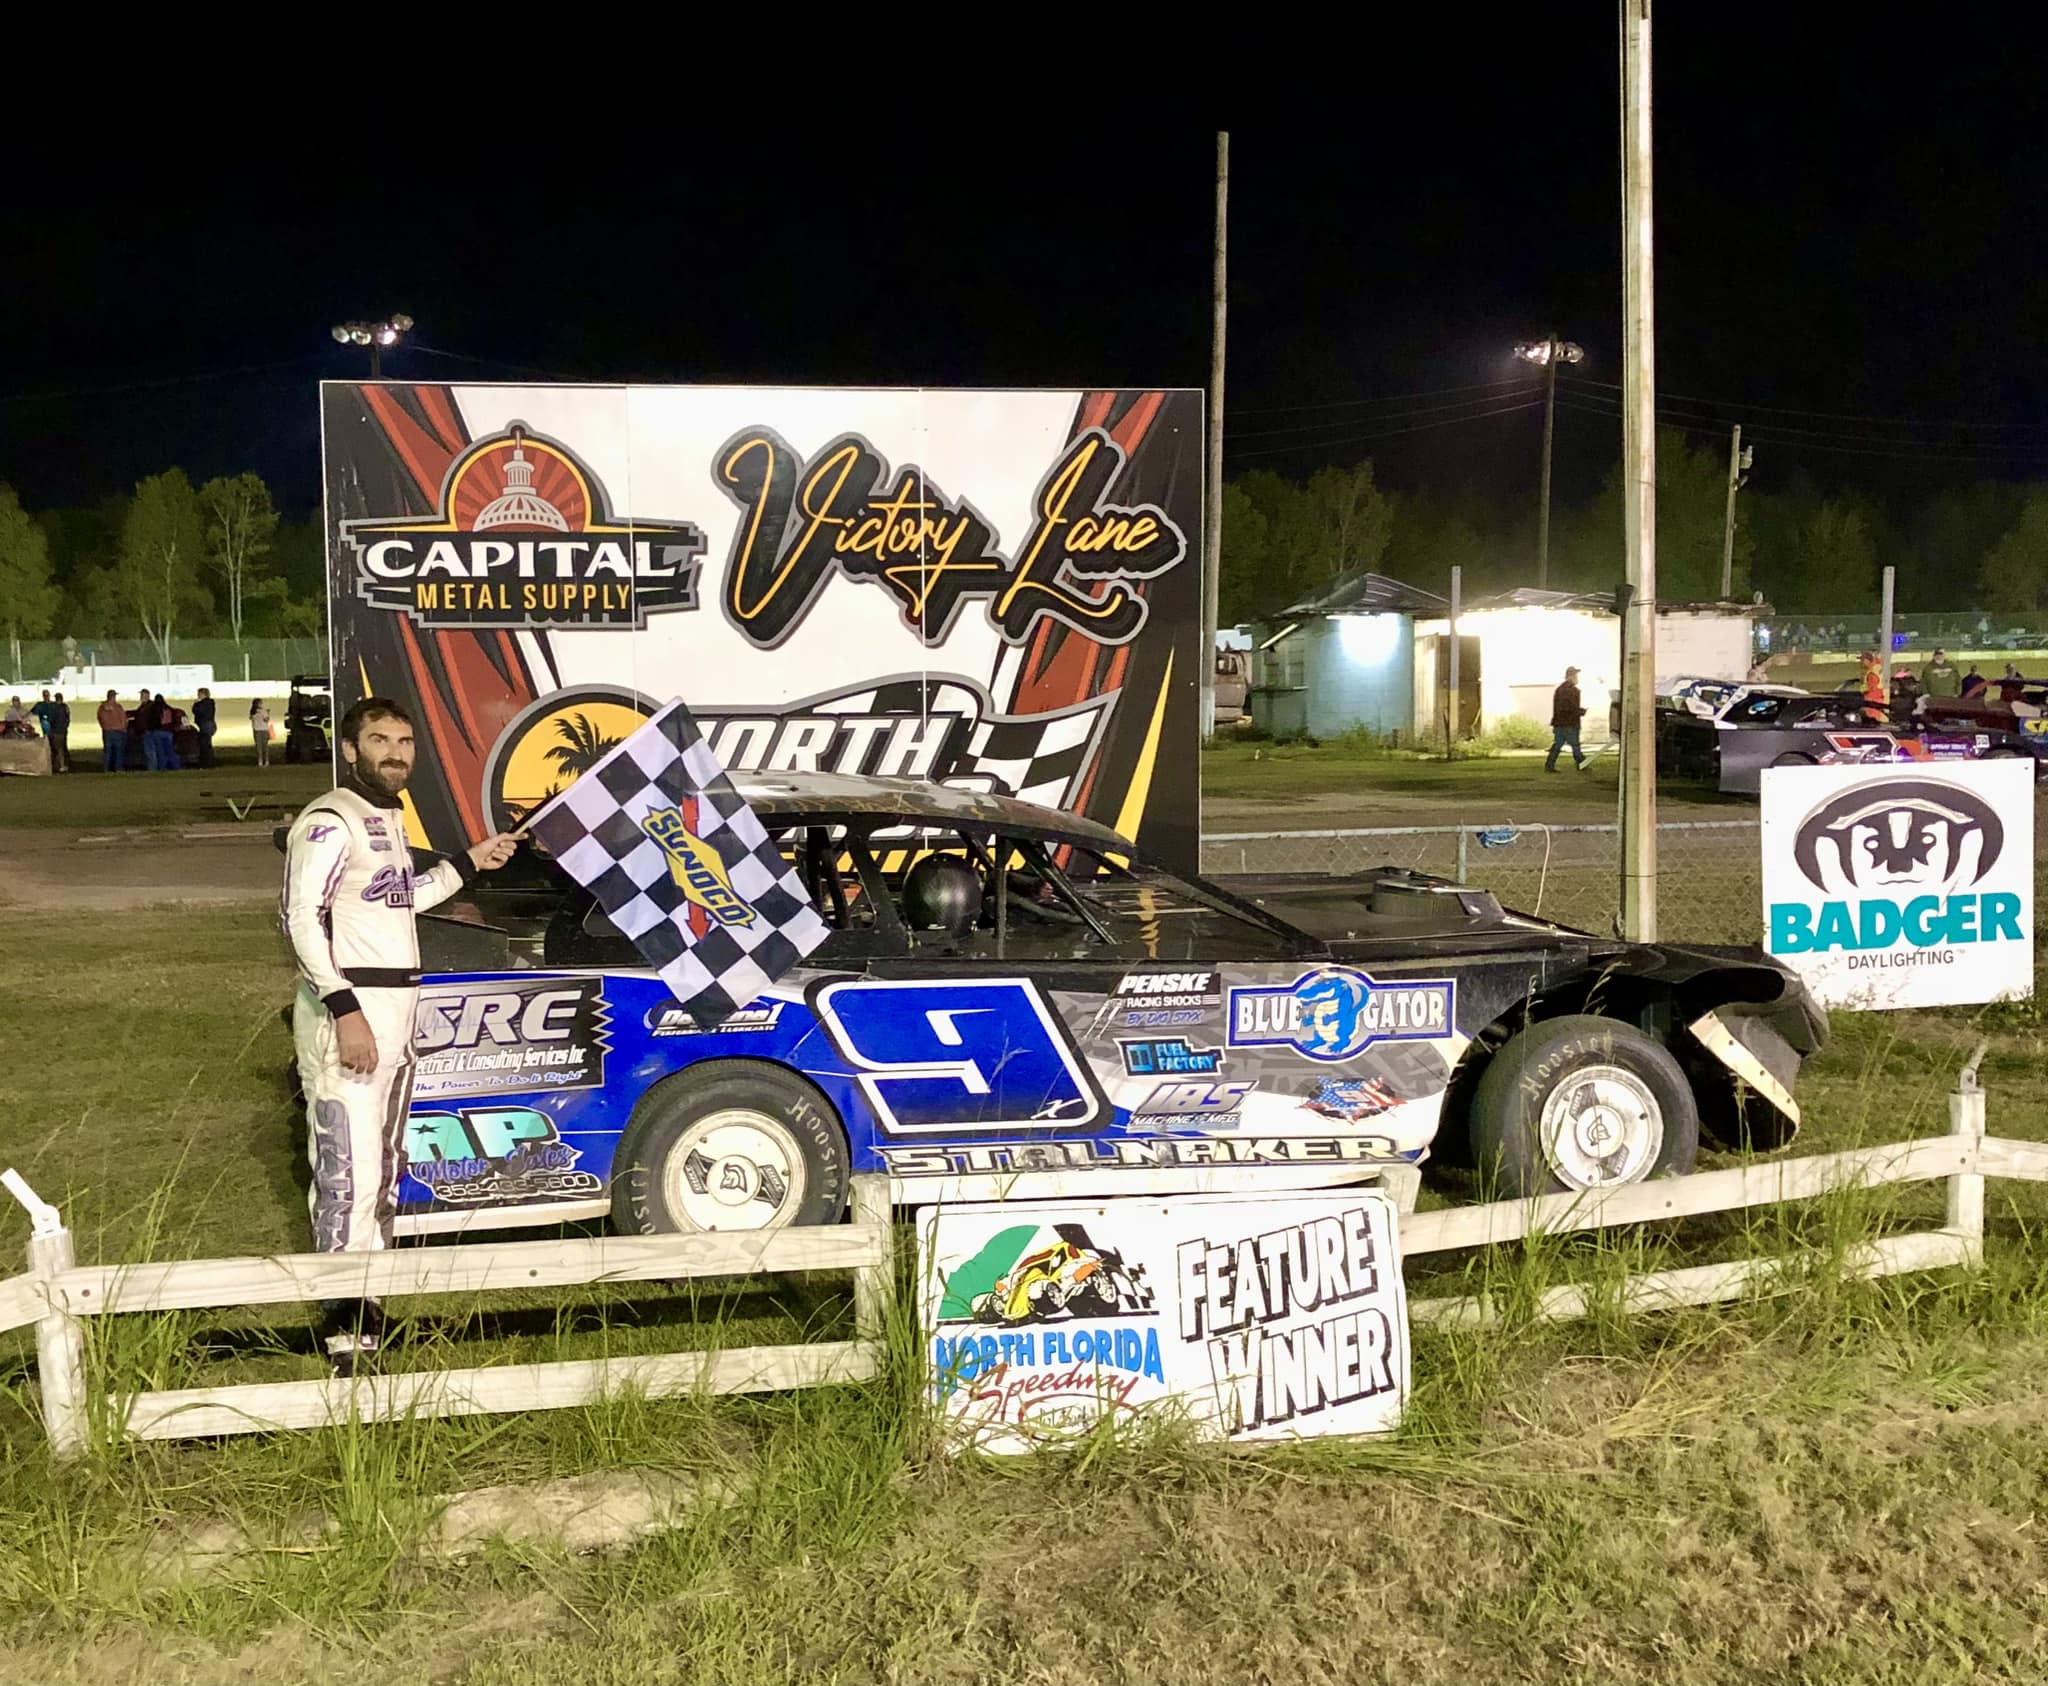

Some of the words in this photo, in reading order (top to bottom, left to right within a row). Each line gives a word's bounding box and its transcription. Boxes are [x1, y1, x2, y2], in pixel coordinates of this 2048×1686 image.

[724, 438, 999, 620] Victory
[997, 439, 1160, 619] Lane
[366, 540, 676, 579] CAPITAL
[417, 583, 511, 610] METAL
[523, 584, 631, 611] SUPPLY
[649, 813, 750, 922] SUNOCO
[1769, 891, 2025, 955] BADGER
[1848, 949, 1954, 970] DAYLIGHTING
[1117, 972, 1212, 994] PENSKE
[1127, 996, 1162, 1008] RACING
[1163, 995, 1201, 1007] SHOCKS
[1237, 994, 1303, 1037] BLUE
[1363, 990, 1447, 1034] GATOR
[466, 1049, 525, 1074] Consulting
[523, 1046, 571, 1067] Services
[569, 1044, 587, 1065] Inc
[815, 977, 1099, 1133] 9
[1155, 1043, 1188, 1056] FUEL
[1158, 1055, 1214, 1071] FACTORY
[441, 1079, 481, 1090] Power
[507, 1075, 529, 1085] Do
[1132, 1114, 1194, 1126] MACHINE
[414, 1156, 491, 1185] Motor
[872, 1136, 1402, 1177] STALNAKER
[1176, 1207, 1379, 1344] FEATURE
[935, 1331, 1035, 1399] NORTH
[1043, 1327, 1165, 1385] FLORIDA
[1207, 1307, 1396, 1436] WINNER
[956, 1360, 1140, 1421] Speedway
